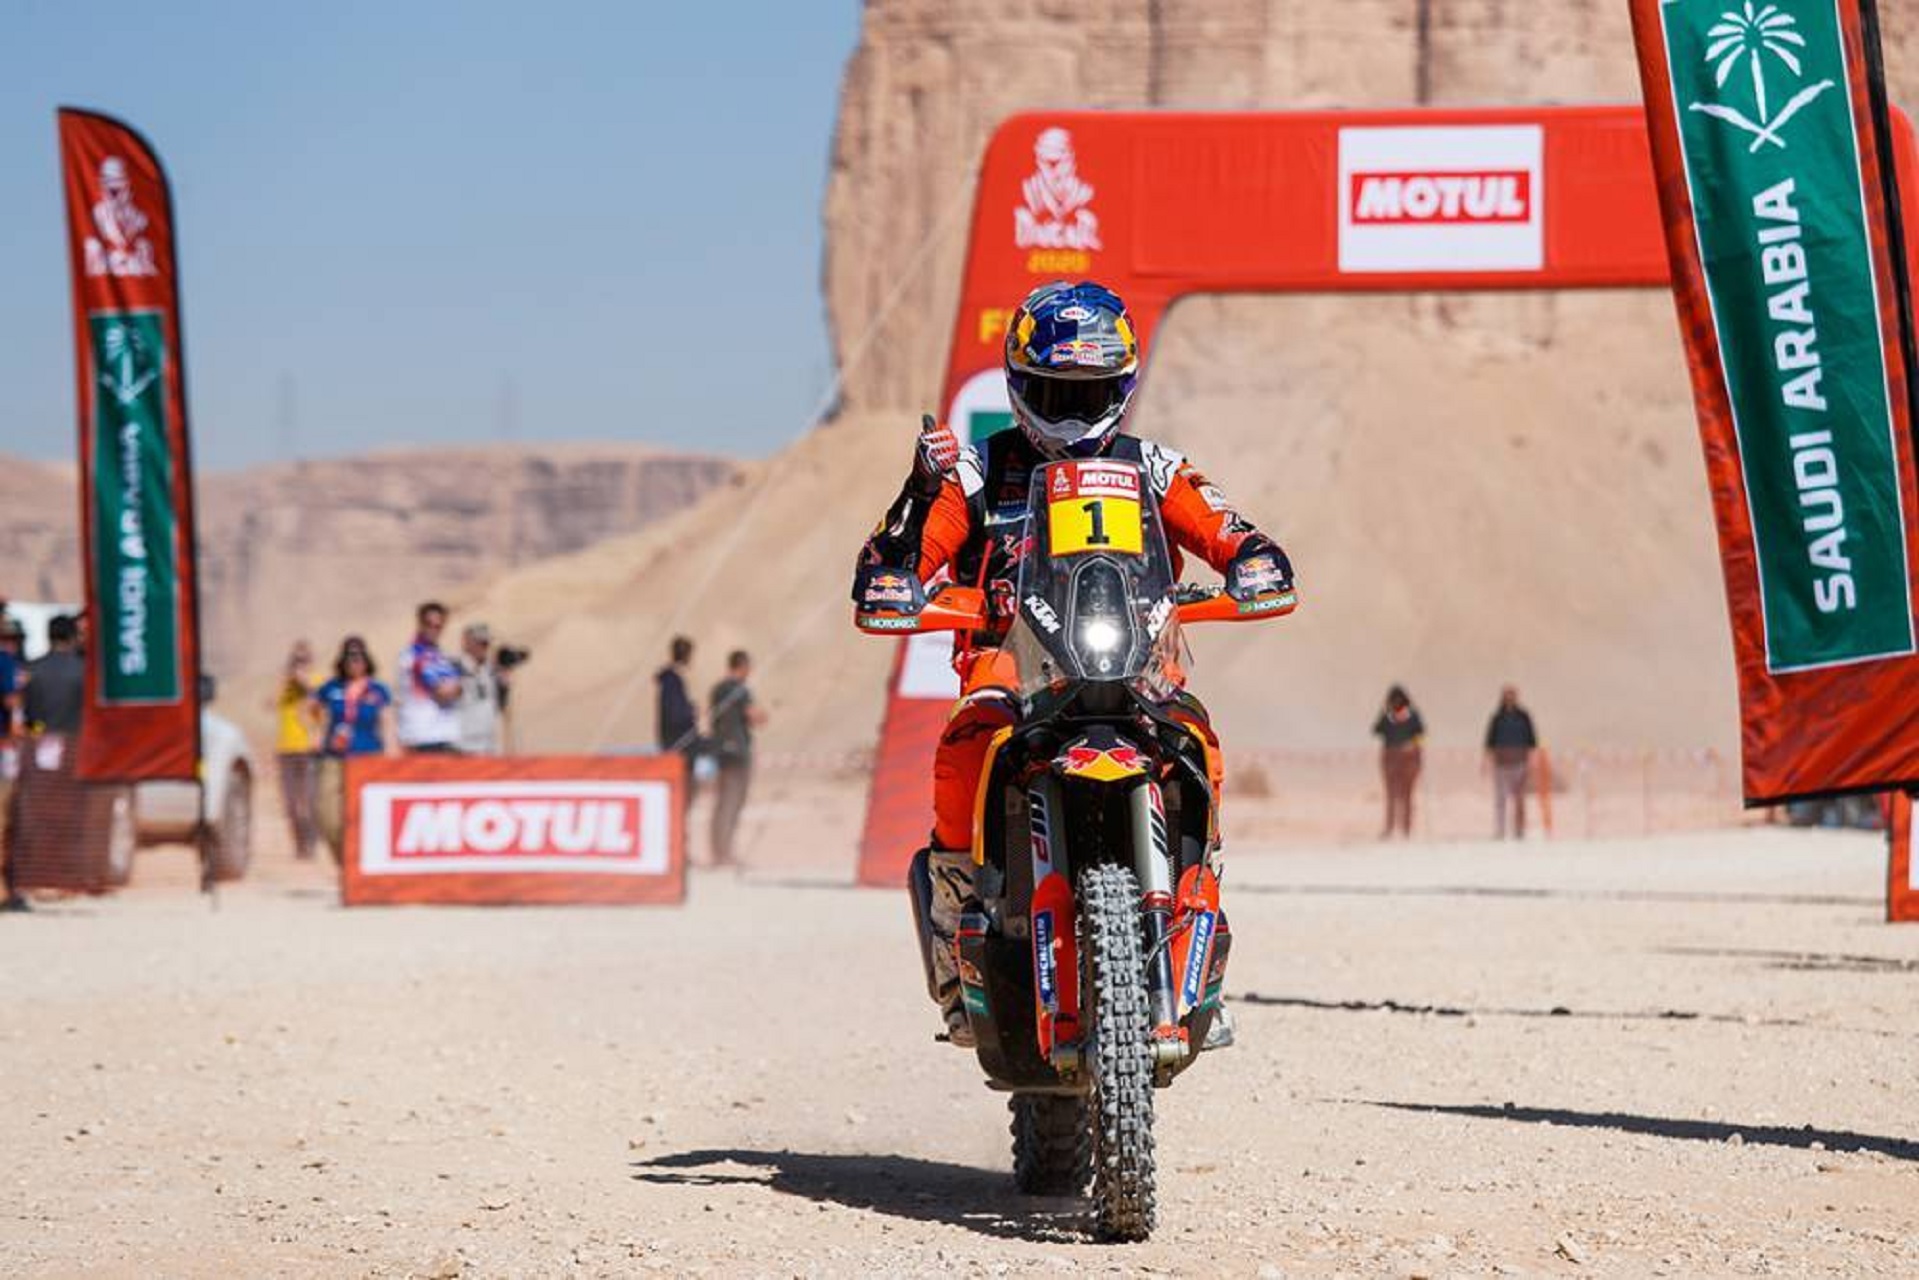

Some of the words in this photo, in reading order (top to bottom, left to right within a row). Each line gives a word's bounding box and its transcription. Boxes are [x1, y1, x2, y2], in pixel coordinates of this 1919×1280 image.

[1355, 176, 1525, 219] MOTUL
[1752, 177, 1829, 411] ARABIA
[1081, 471, 1135, 488] MOTUL
[1082, 501, 1110, 544] 1
[1789, 428, 1857, 614] SAUDI
[119, 566, 147, 676] SAUDI
[1025, 595, 1061, 633] KTM
[397, 801, 633, 854] MOTUL
[1188, 916, 1209, 993] MICHELIN
